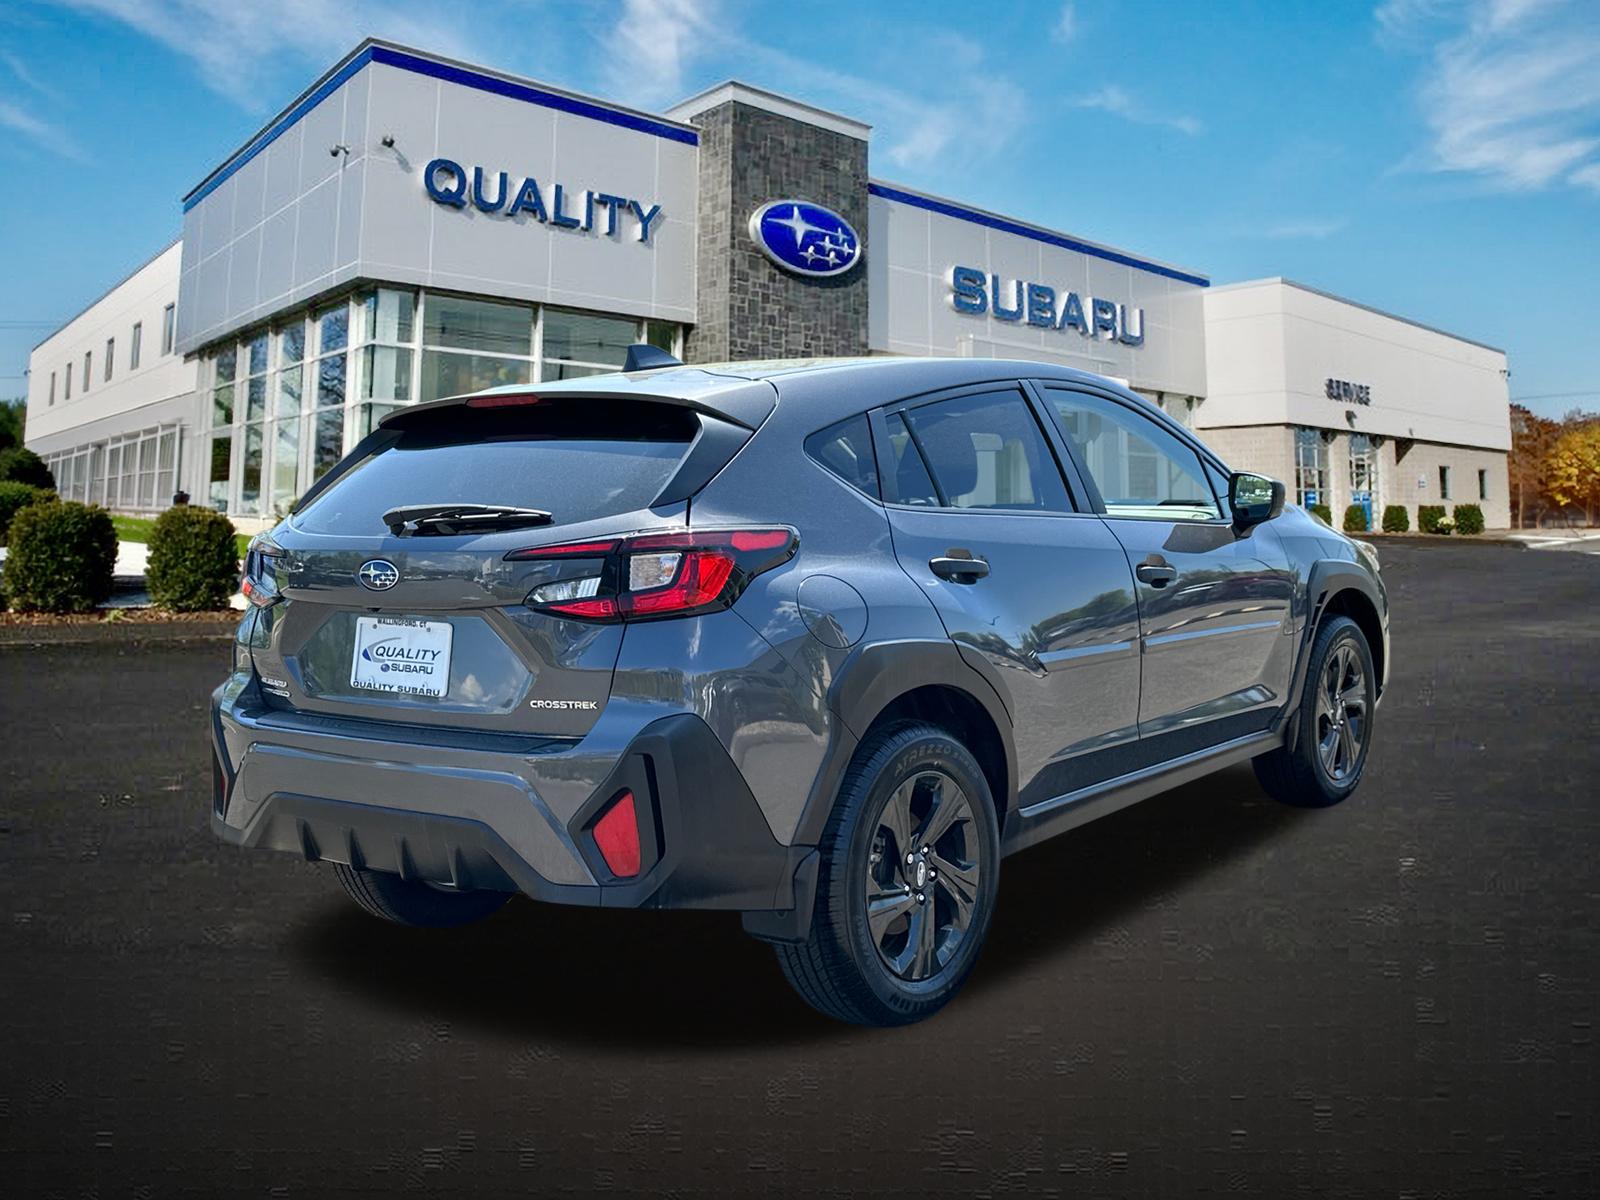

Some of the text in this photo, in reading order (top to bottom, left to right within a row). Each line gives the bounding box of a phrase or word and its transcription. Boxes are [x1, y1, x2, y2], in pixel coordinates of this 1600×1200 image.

[424, 158, 662, 243] QUALITY
[950, 266, 1145, 347] SUBARU
[1325, 378, 1371, 407] SERVICE
[419, 621, 427, 629] CT
[375, 646, 442, 661] QUALITY
[390, 663, 433, 675] SUBARU
[353, 680, 440, 697] QUALITY SUBARU
[530, 700, 598, 710] CROSSTREK
